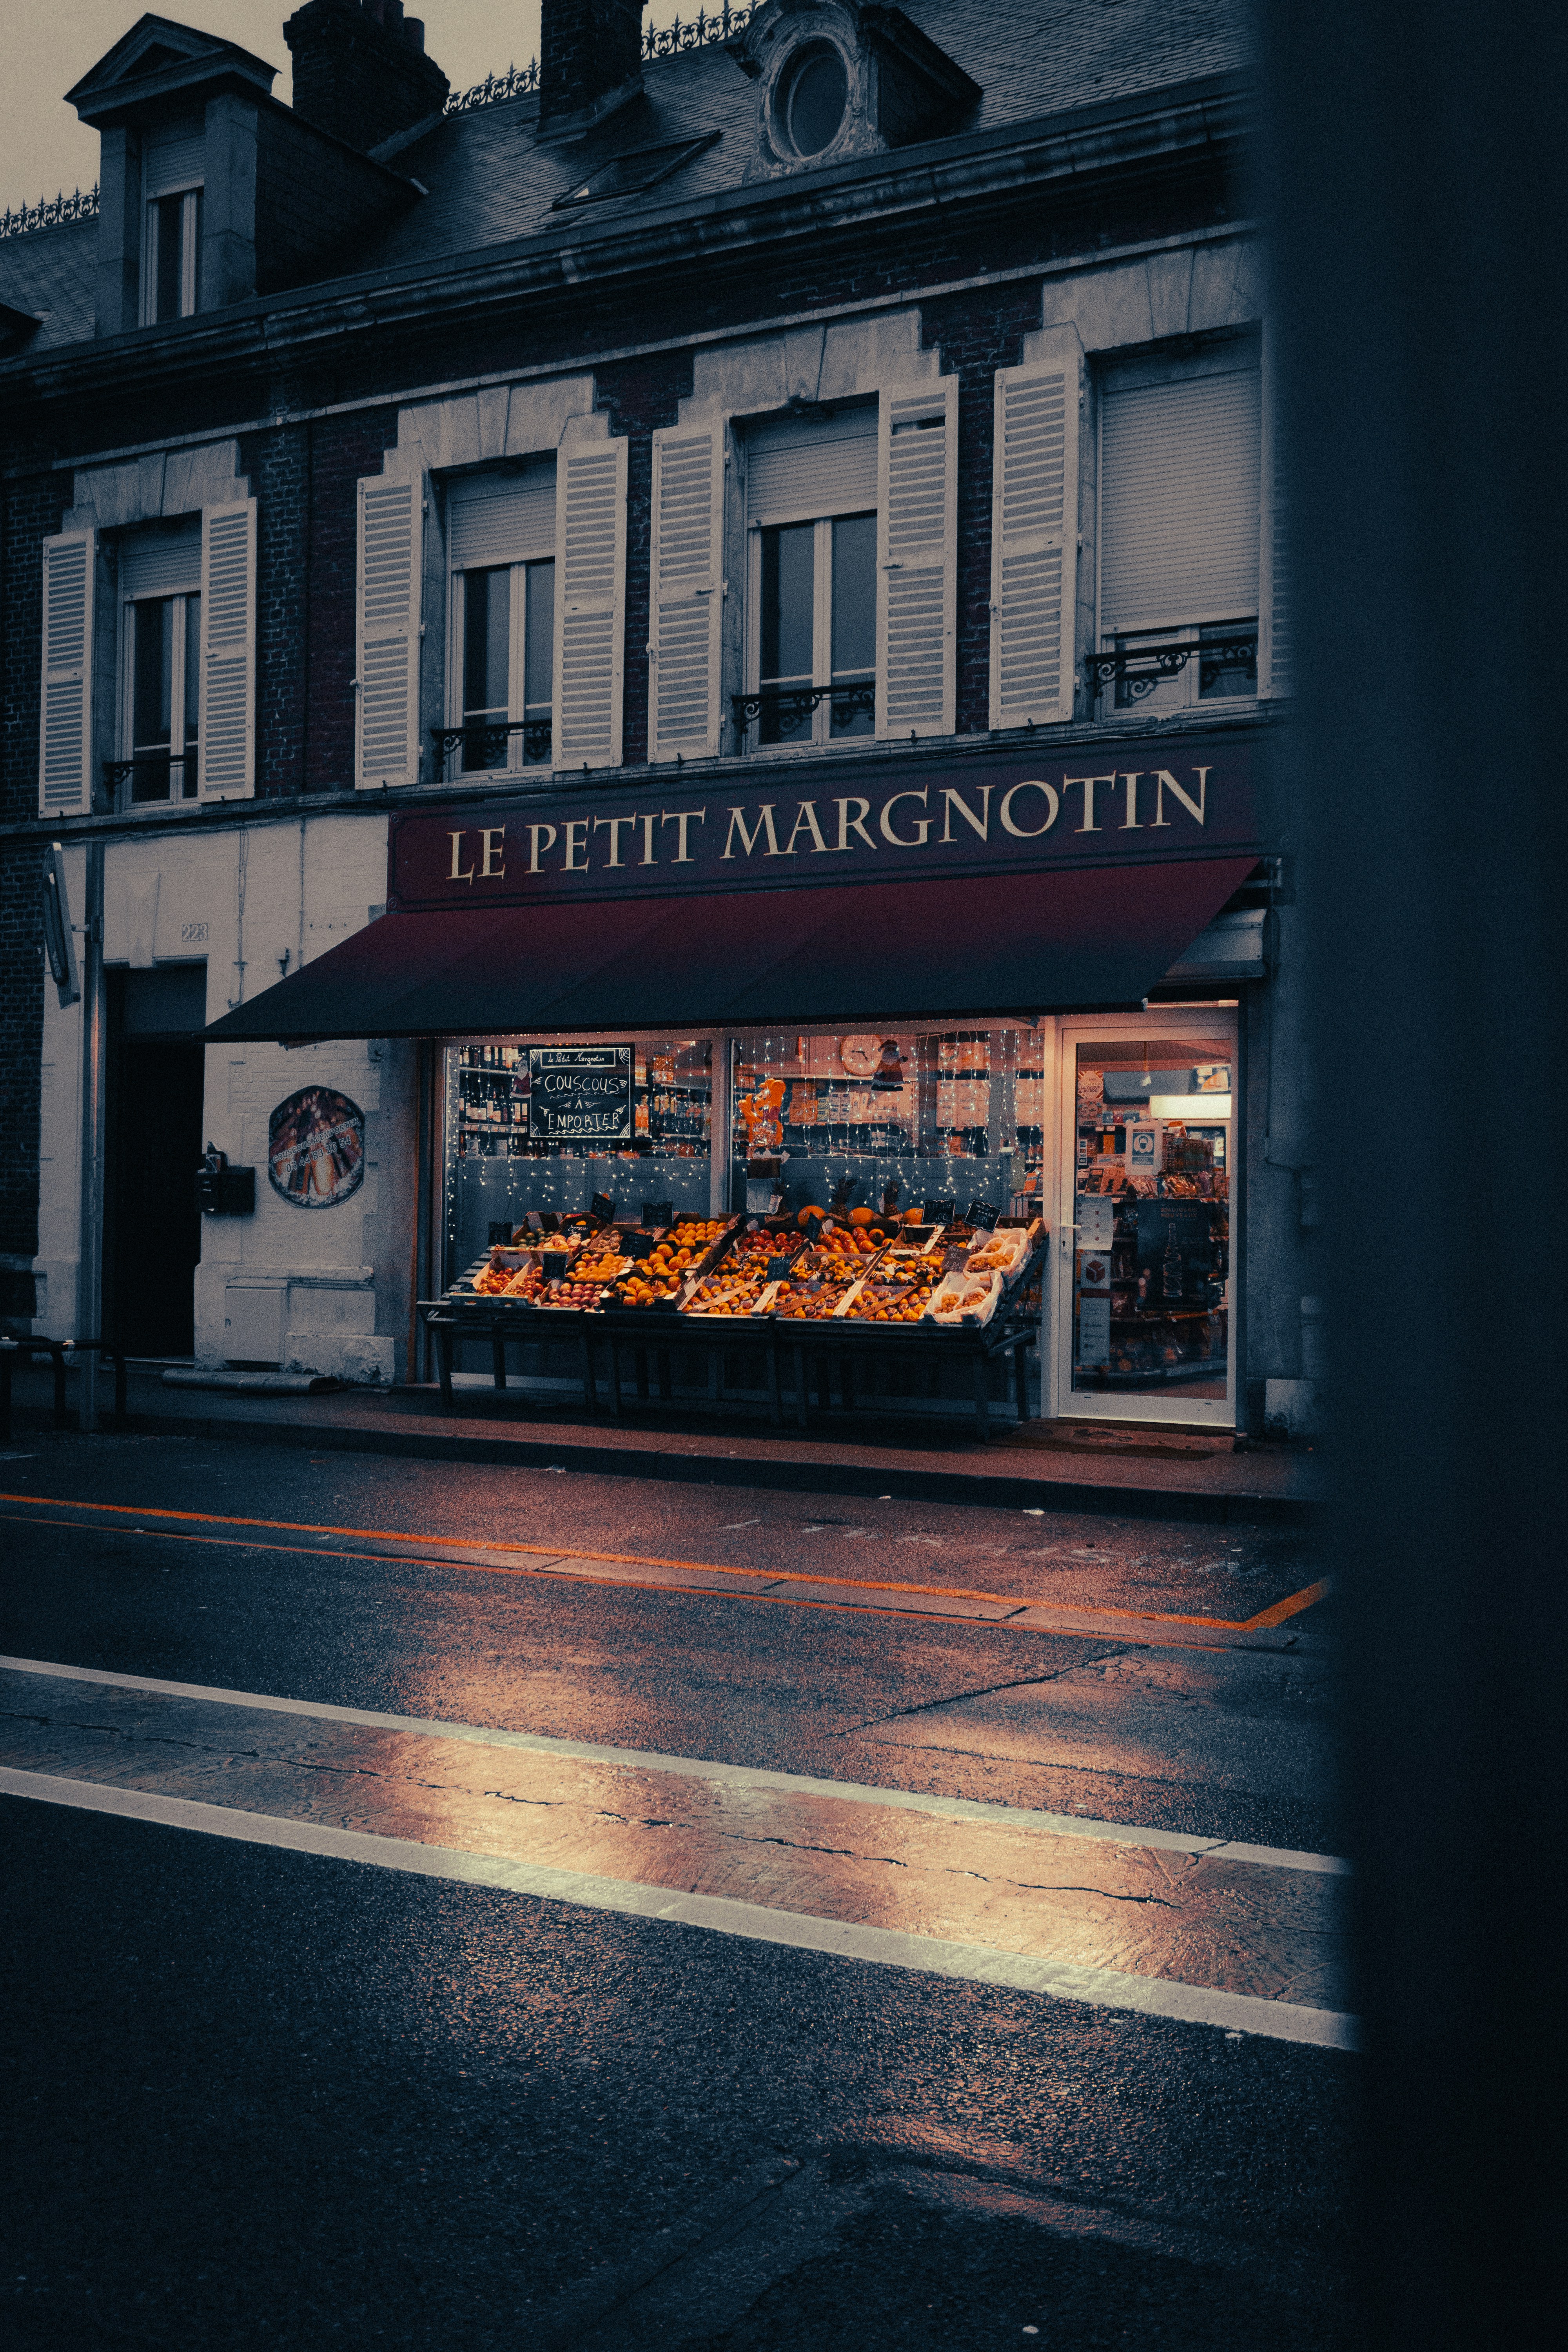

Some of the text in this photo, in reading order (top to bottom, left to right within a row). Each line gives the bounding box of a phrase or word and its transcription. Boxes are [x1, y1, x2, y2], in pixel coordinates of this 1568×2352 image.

[445, 766, 1213, 886] LE PETIT MARGNOTIN
[183, 924, 207, 941] 223
[555, 1052, 570, 1062] Petit
[544, 1075, 619, 1093] COUSCOUS
[548, 1112, 620, 1129] EMPORTER
[272, 1141, 312, 1163] COUSCOUS
[319, 1117, 359, 1141] EMPORTER
[286, 1135, 352, 1172] 03 44 83 26 54
